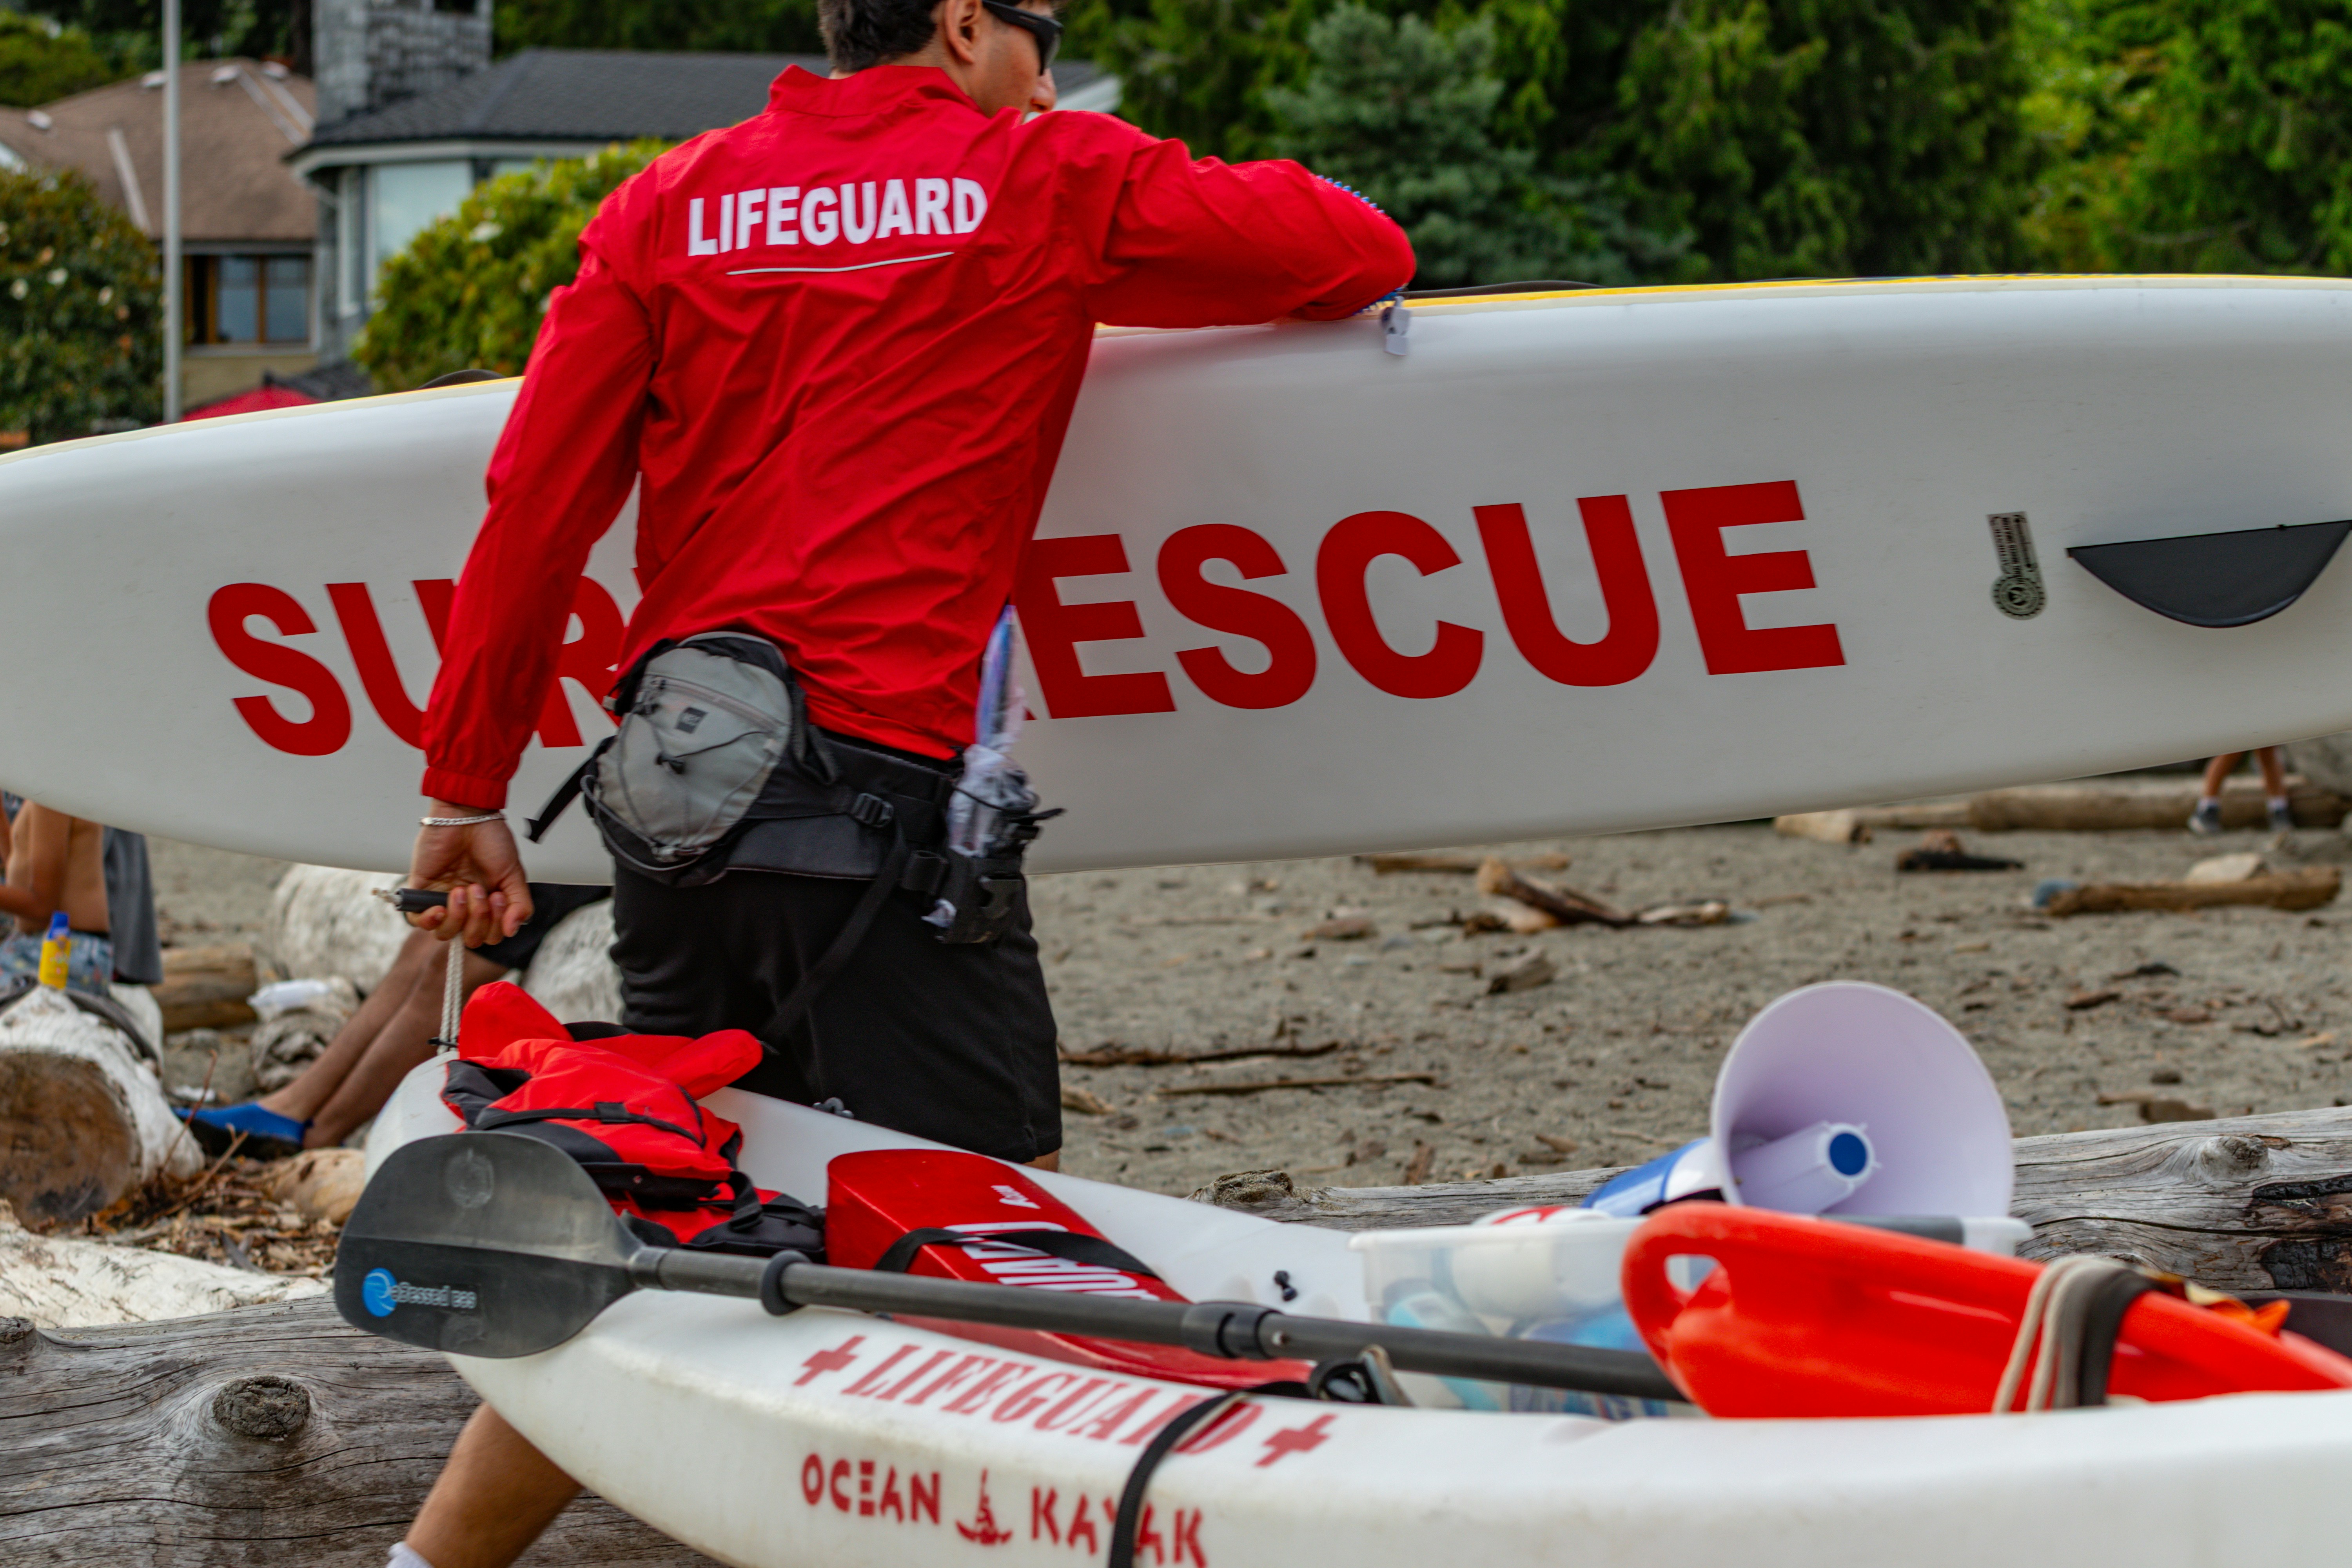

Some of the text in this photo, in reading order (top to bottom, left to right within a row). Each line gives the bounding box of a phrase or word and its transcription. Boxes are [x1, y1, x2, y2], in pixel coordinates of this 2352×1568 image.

[688, 177, 988, 256] LIFEGUARD
[206, 567, 644, 756] SUR
[1015, 480, 1846, 720] ESCUE
[801, 1453, 941, 1525] OCEAN
